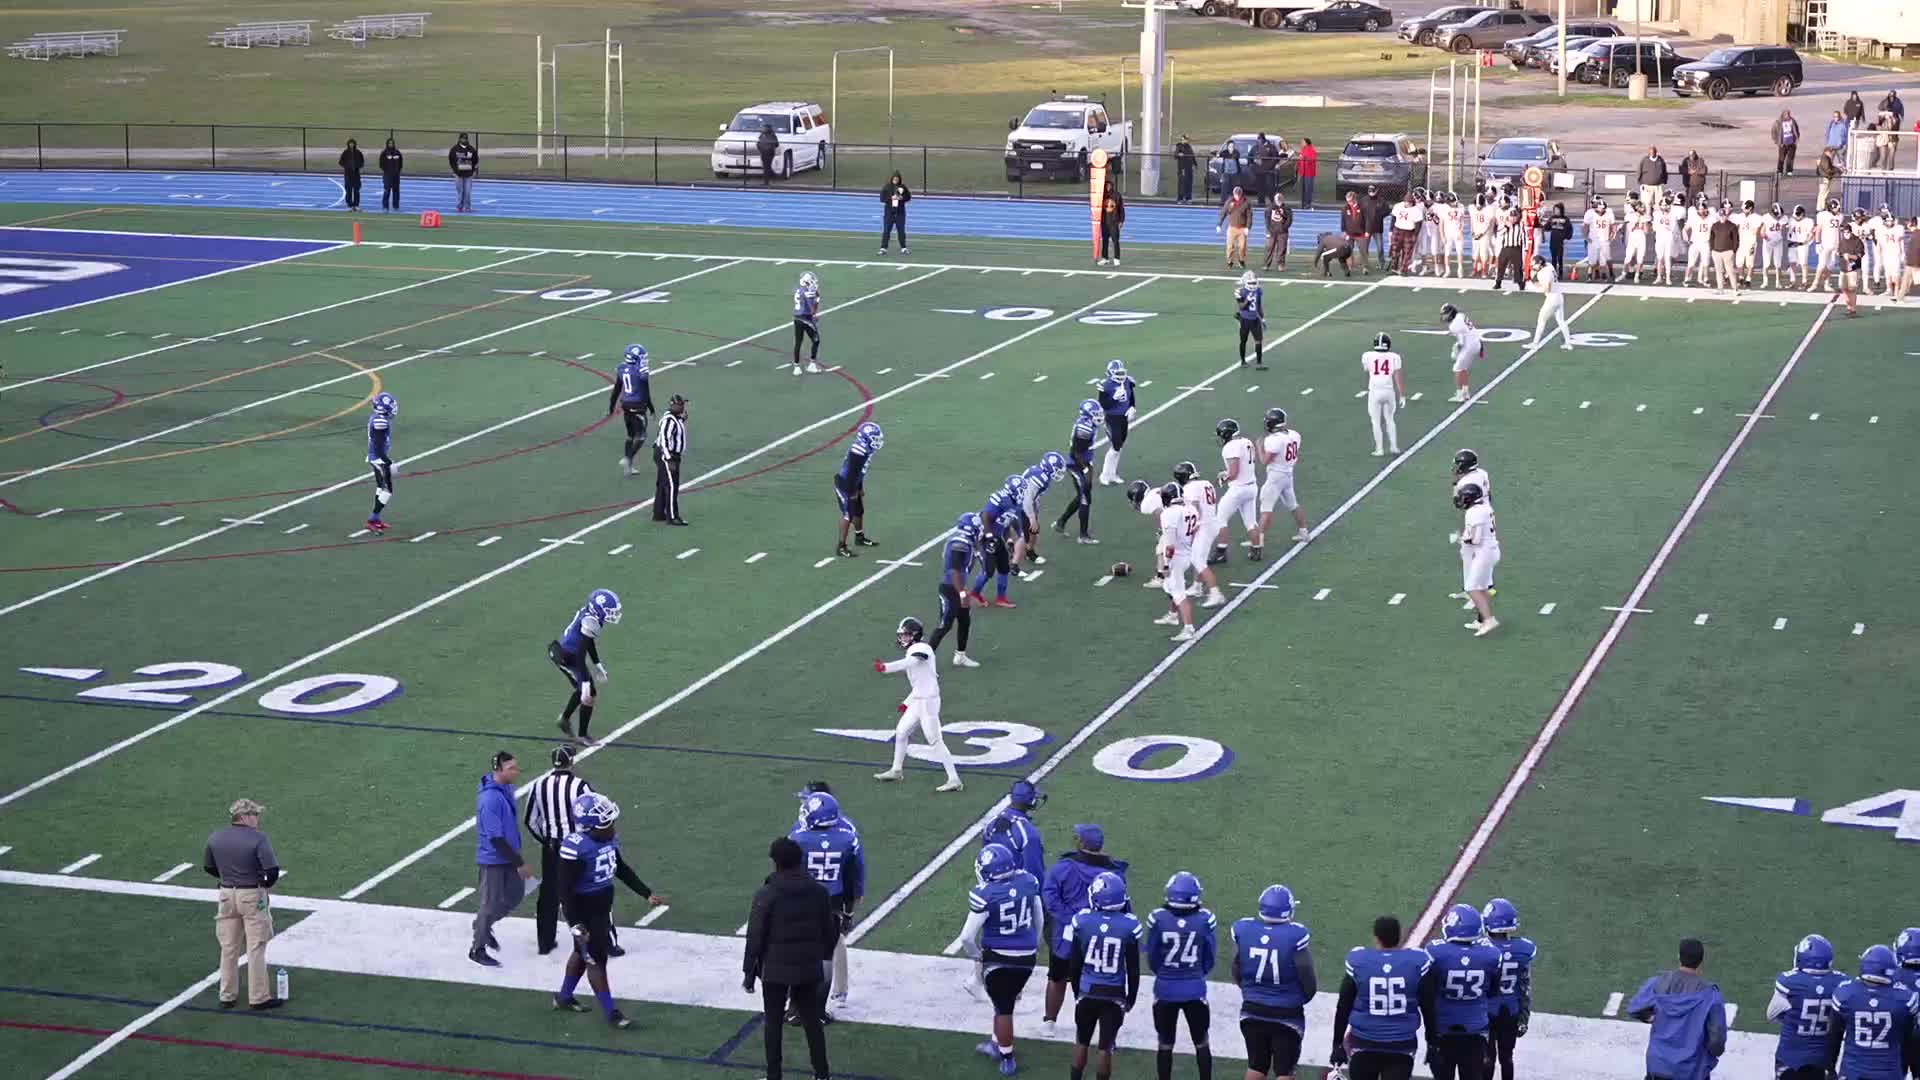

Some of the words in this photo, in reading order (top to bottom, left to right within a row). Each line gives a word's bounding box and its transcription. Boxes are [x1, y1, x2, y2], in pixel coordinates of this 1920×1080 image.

[1373, 358, 1390, 376] 14
[807, 851, 842, 881] 55
[999, 895, 1032, 935] 54
[1084, 935, 1121, 974] 40
[1161, 931, 1198, 968] 24
[1249, 946, 1281, 985] 71
[1369, 976, 1406, 1016] 66
[1446, 969, 1485, 1001] 53
[1854, 1011, 1892, 1049] 62
